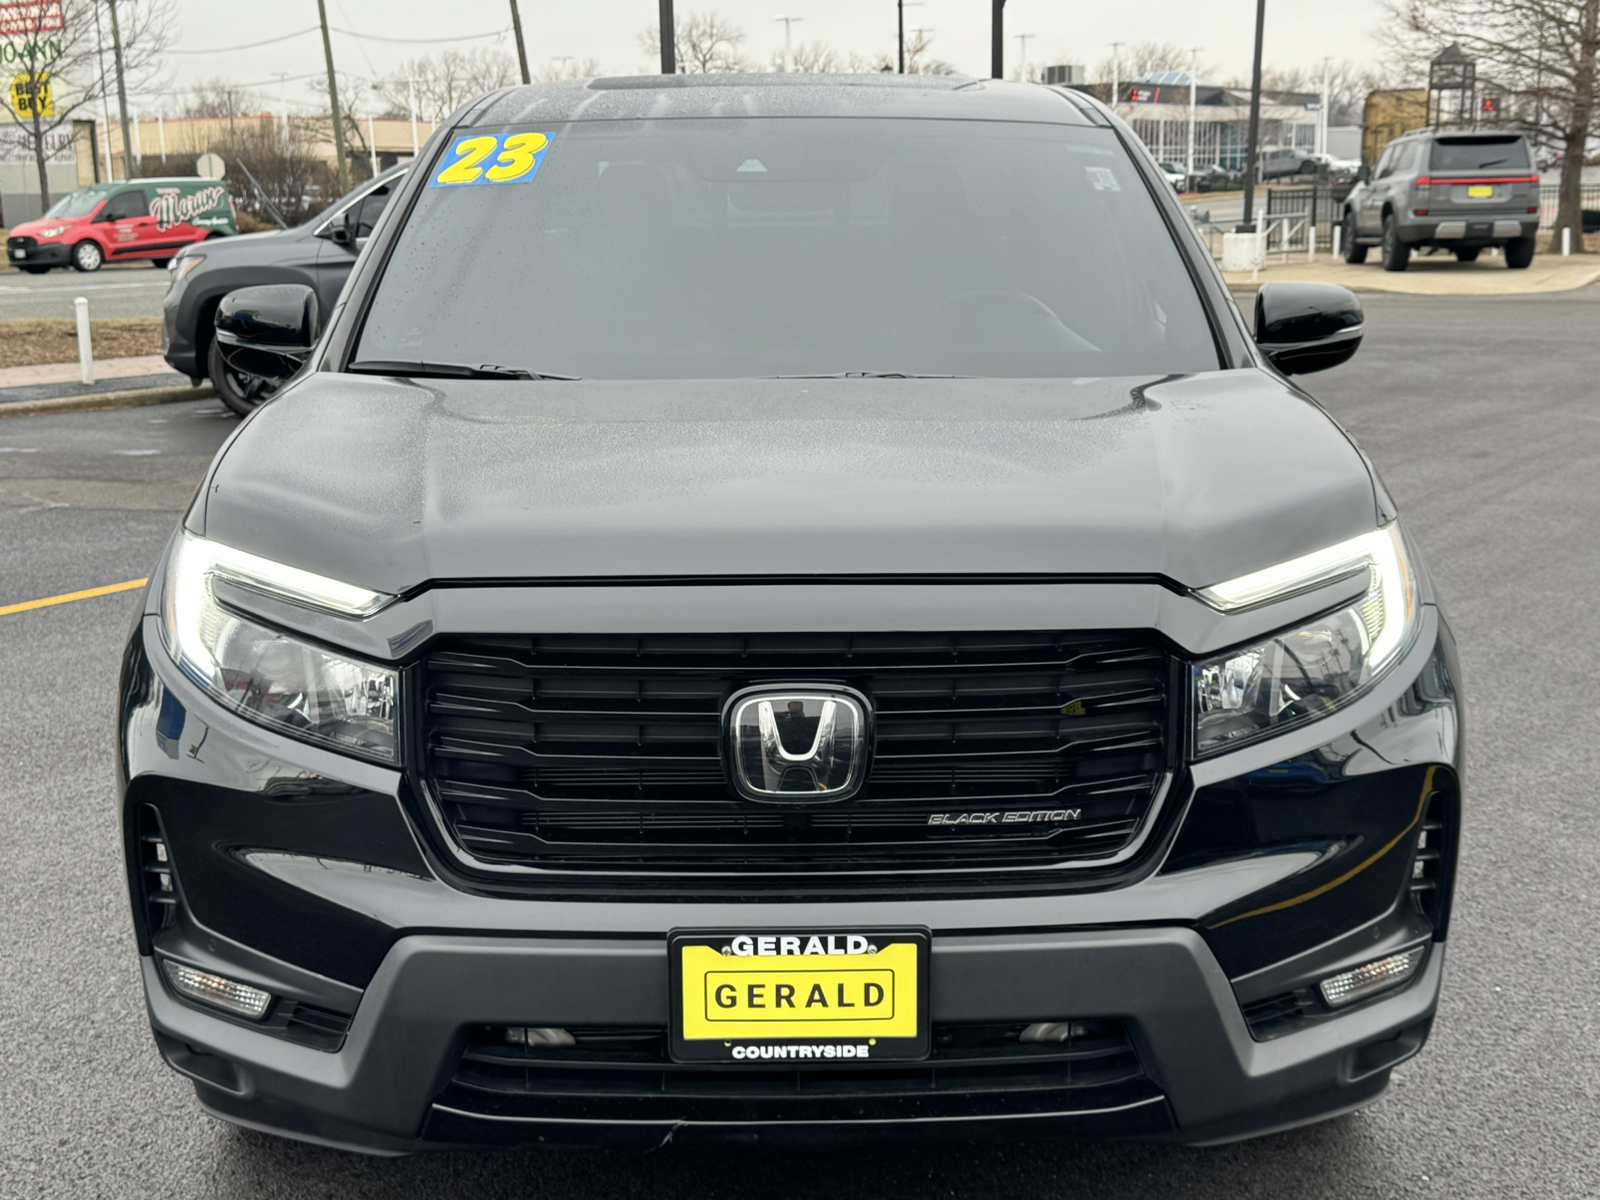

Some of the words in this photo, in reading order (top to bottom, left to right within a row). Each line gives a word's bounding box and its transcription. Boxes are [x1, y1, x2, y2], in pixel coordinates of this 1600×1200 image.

[437, 132, 548, 184] 23
[928, 812, 999, 825] BLACK
[1002, 809, 1081, 823] EDITION
[731, 935, 868, 957] GERALD
[714, 982, 885, 1009] GERALD
[731, 1044, 869, 1060] COUNTRYSIDE
